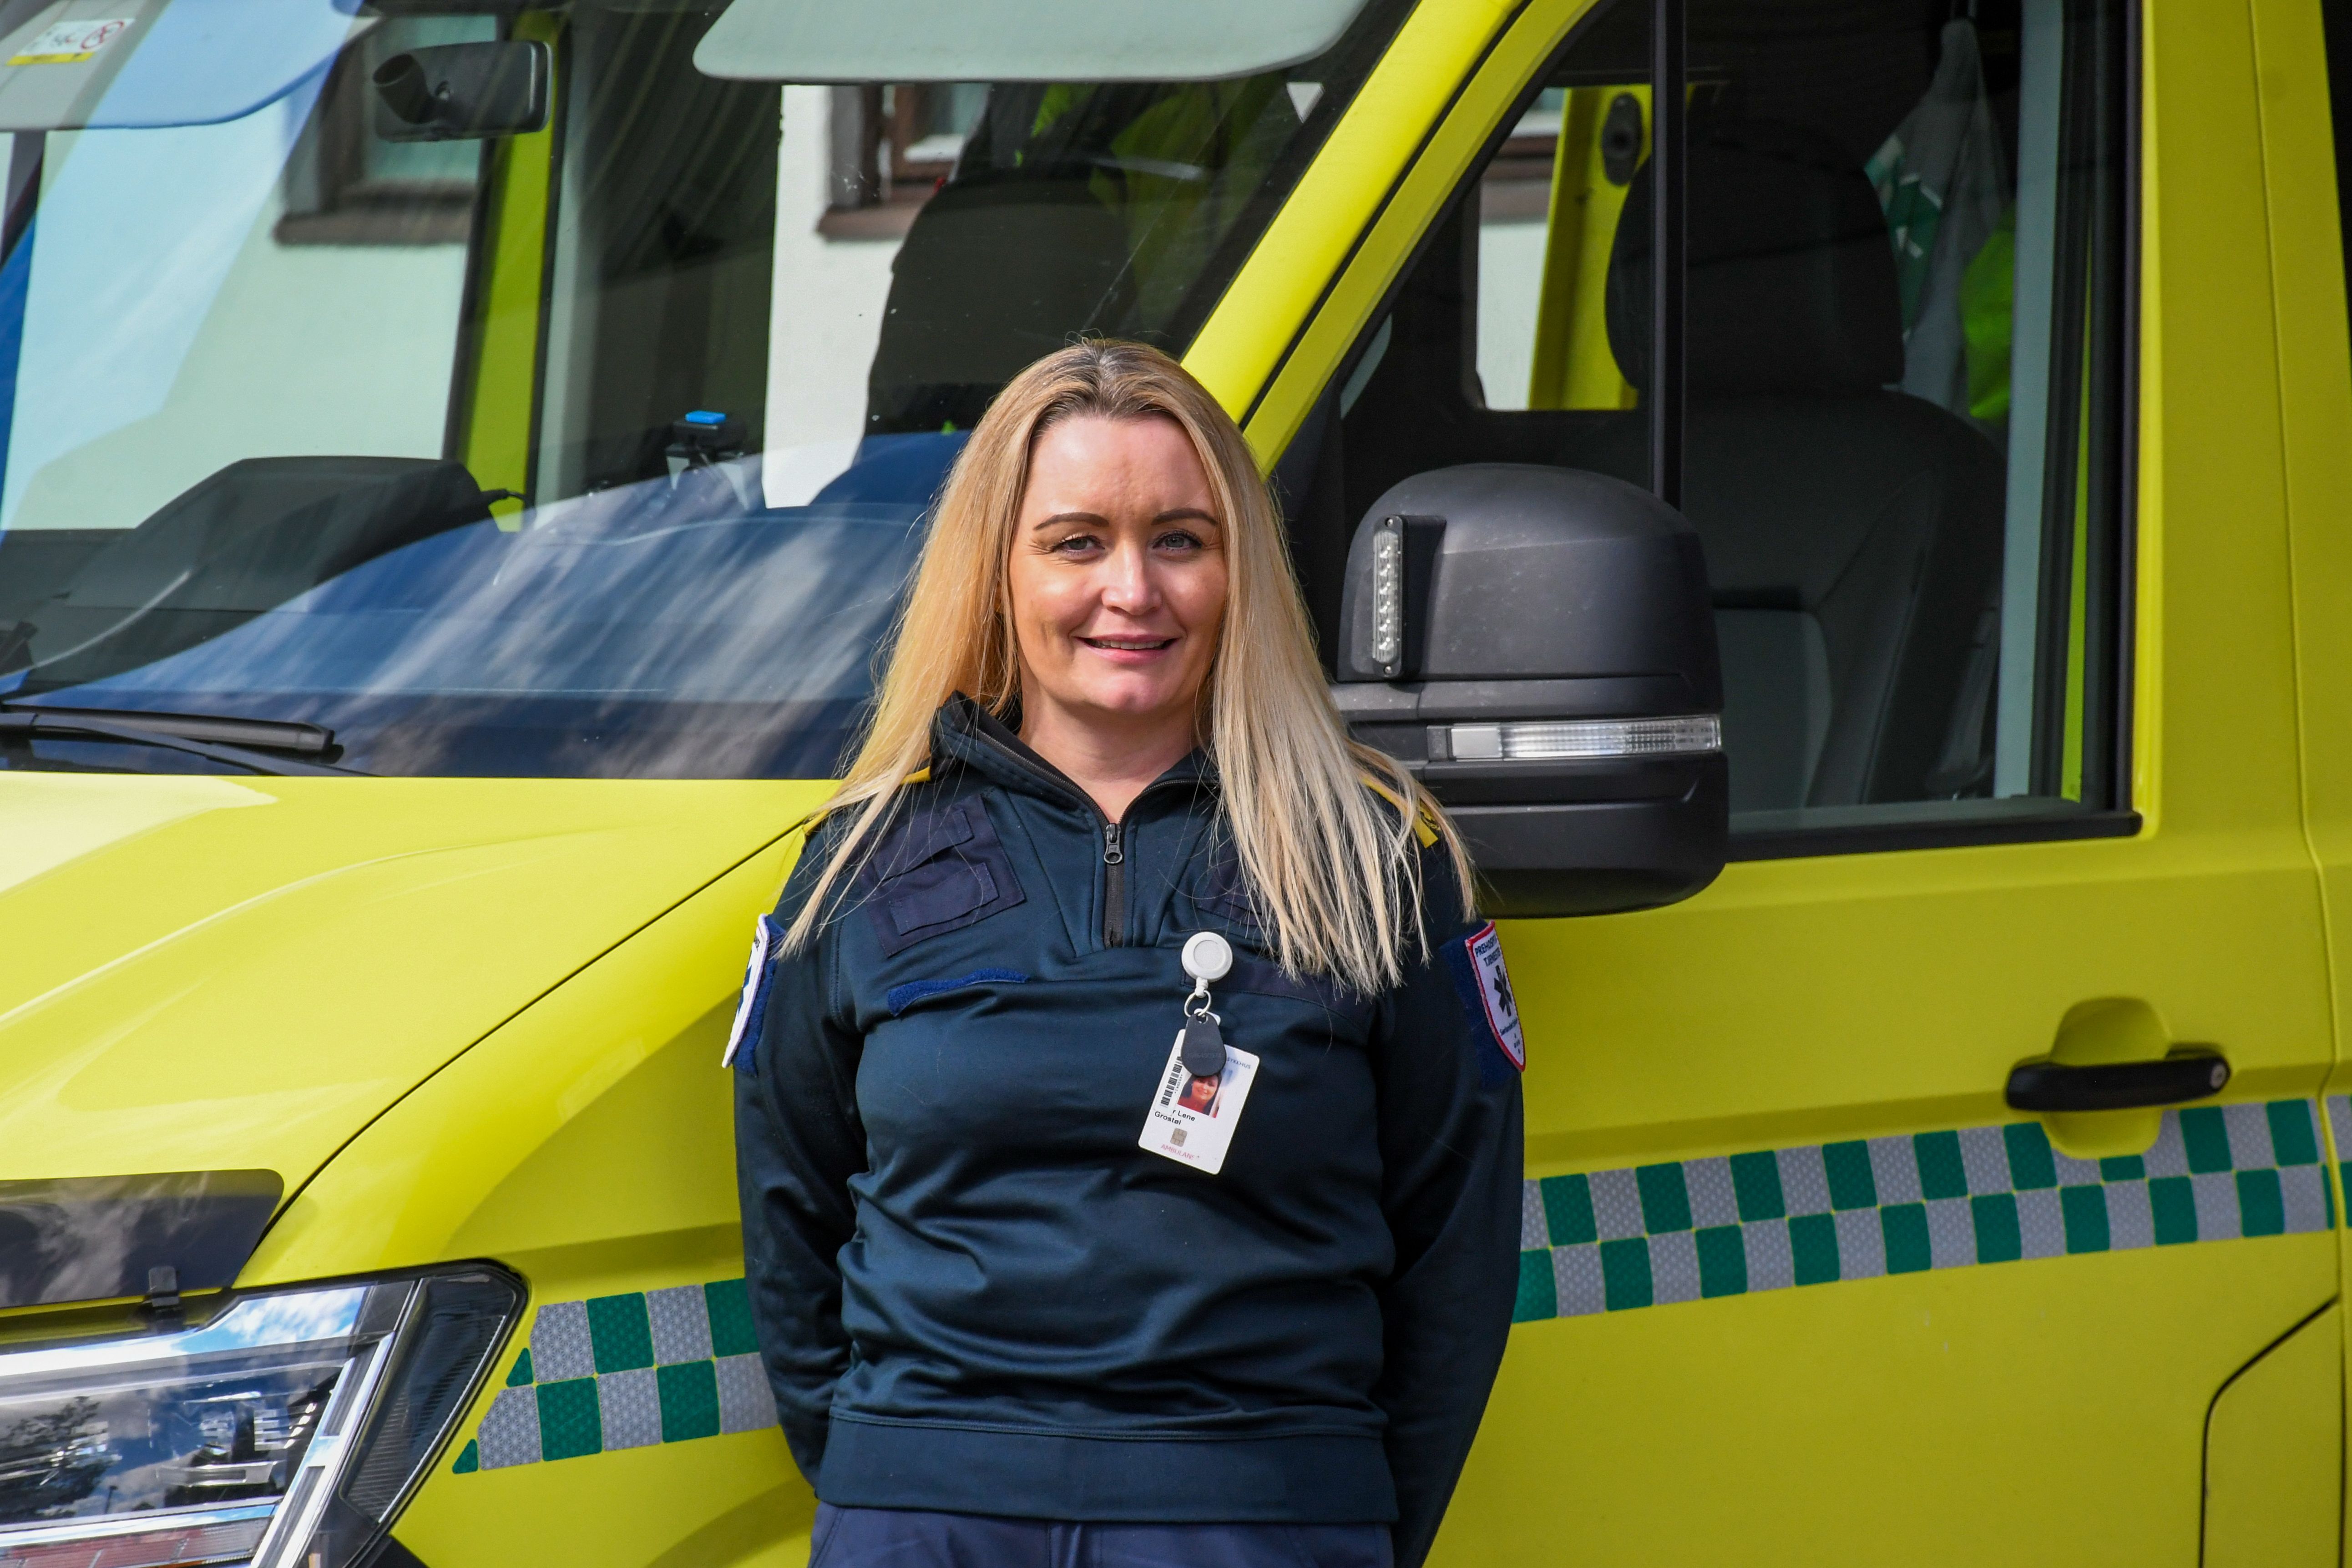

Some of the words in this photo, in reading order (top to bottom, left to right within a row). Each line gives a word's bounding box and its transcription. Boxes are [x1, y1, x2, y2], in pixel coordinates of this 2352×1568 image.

[1227, 1057, 1251, 1069] SYKEHUS
[1154, 1111, 1182, 1125] Grostøl
[1178, 1110, 1195, 1121] Lene
